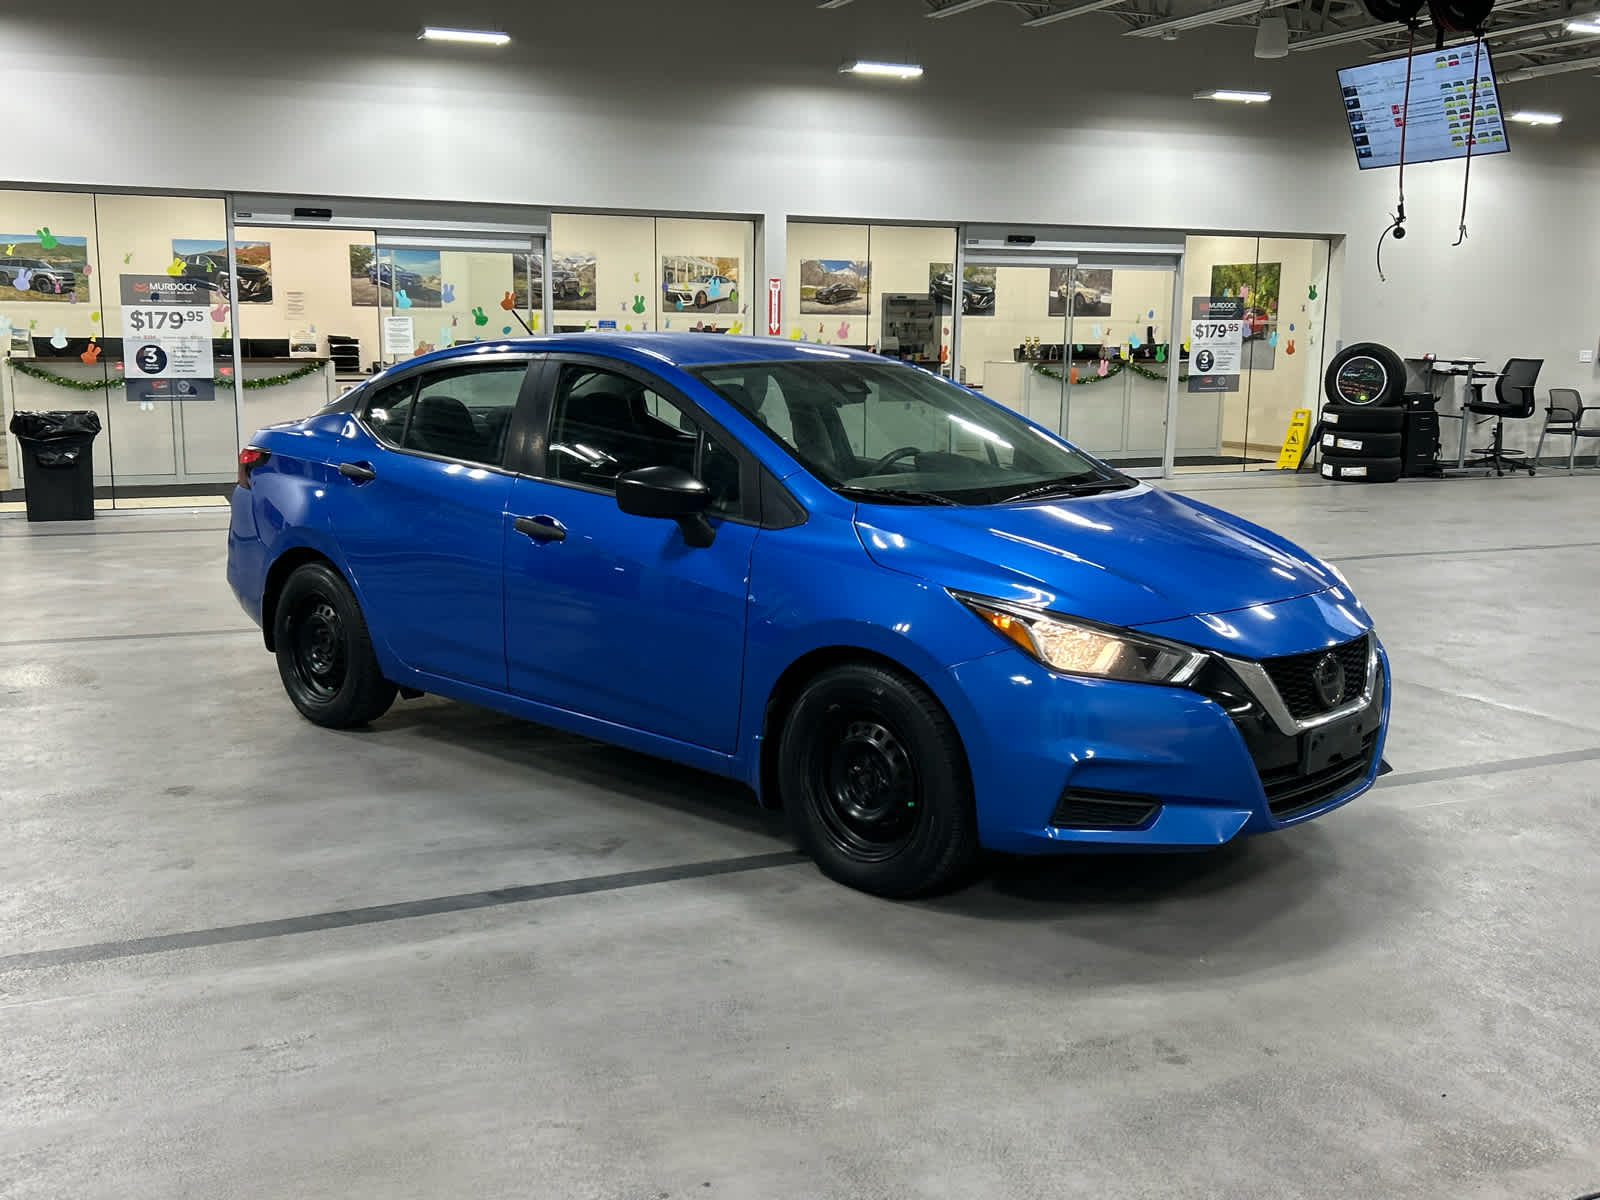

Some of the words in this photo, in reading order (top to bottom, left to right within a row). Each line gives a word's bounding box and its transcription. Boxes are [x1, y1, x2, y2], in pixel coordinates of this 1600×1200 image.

[149, 283, 197, 291] MURDOCK
[144, 347, 157, 363] 3
[1201, 352, 1209, 364] 3
